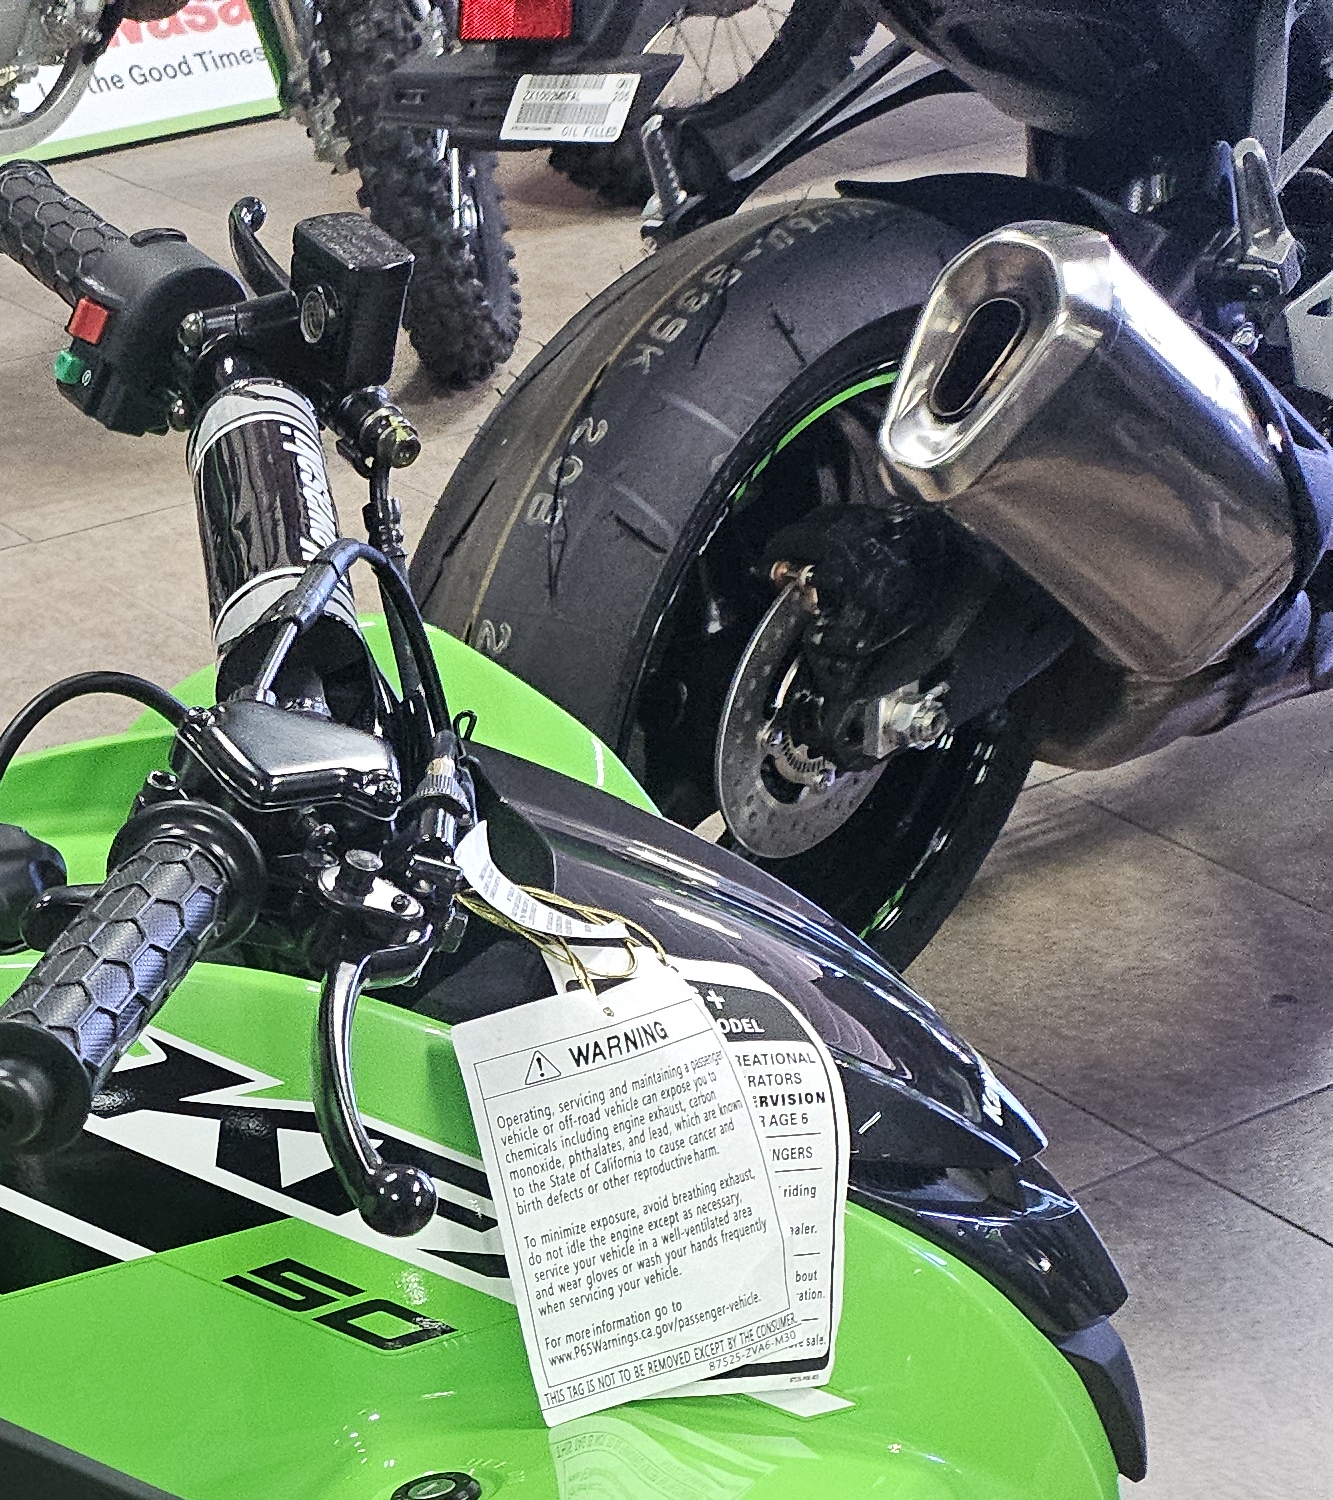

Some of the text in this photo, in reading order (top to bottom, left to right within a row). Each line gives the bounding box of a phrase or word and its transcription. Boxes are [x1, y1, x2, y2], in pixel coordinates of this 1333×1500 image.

[128, 55, 193, 86] Good
[194, 46, 267, 73] Times
[561, 127, 577, 138] OIL
[583, 126, 618, 138] FILLED
[568, 1021, 669, 1068] WARNING
[716, 1018, 766, 1034] ODEL
[497, 1106, 555, 1131] Operating,
[559, 1091, 605, 1113] servicing
[609, 1080, 627, 1098] and
[632, 1065, 683, 1092] maintaining
[684, 1063, 690, 1073] a
[501, 1071, 717, 1146] vehicle or off-road vehicle can expose you to
[748, 1073, 802, 1087] RATORS
[506, 1091, 716, 1163] chemicals including engine exhaust, carbon
[509, 1099, 743, 1181] monoxide, phthalates, and lead, which are known
[769, 1113, 798, 1127] AGE
[801, 1113, 809, 1125] 6
[513, 1117, 735, 1198] to the State of California to cause cancer and
[516, 1145, 720, 1215] birth defects or other reproductive harm.
[772, 1146, 813, 1161] NGERS
[524, 1168, 755, 1249] To minimize exposure, avoid breathing exhaust,
[783, 1184, 817, 1199] riding
[529, 1252, 541, 1266] do
[546, 1246, 563, 1261] not
[566, 1239, 586, 1254] idle
[589, 1234, 607, 1248] the
[610, 1224, 644, 1242] engine
[648, 1211, 679, 1231] except
[683, 1208, 693, 1220] as
[535, 1206, 753, 1282] service your vehicle in a well-ventilated area
[536, 1217, 767, 1299] and wear gloves or wash your hands frequently
[221, 1257, 460, 1352] 50
[538, 1265, 682, 1316] when servicing your vehicle.
[795, 1270, 818, 1282] bout
[797, 1288, 826, 1302] ation.
[545, 1300, 682, 1350] For more information go to
[548, 1291, 761, 1366] www.P65Warnings.ca.gov/passenger-vehicle.
[544, 1388, 565, 1406] THIS
[567, 1383, 584, 1396] TAG
[587, 1379, 595, 1393] IS
[598, 1372, 615, 1389] NOT
[618, 1369, 631, 1383] TO
[634, 1364, 645, 1378] BE
[647, 1351, 691, 1373] REMOVED
[694, 1340, 724, 1362] EXCEPT
[727, 1337, 737, 1350] BY
[739, 1330, 754, 1346] THE
